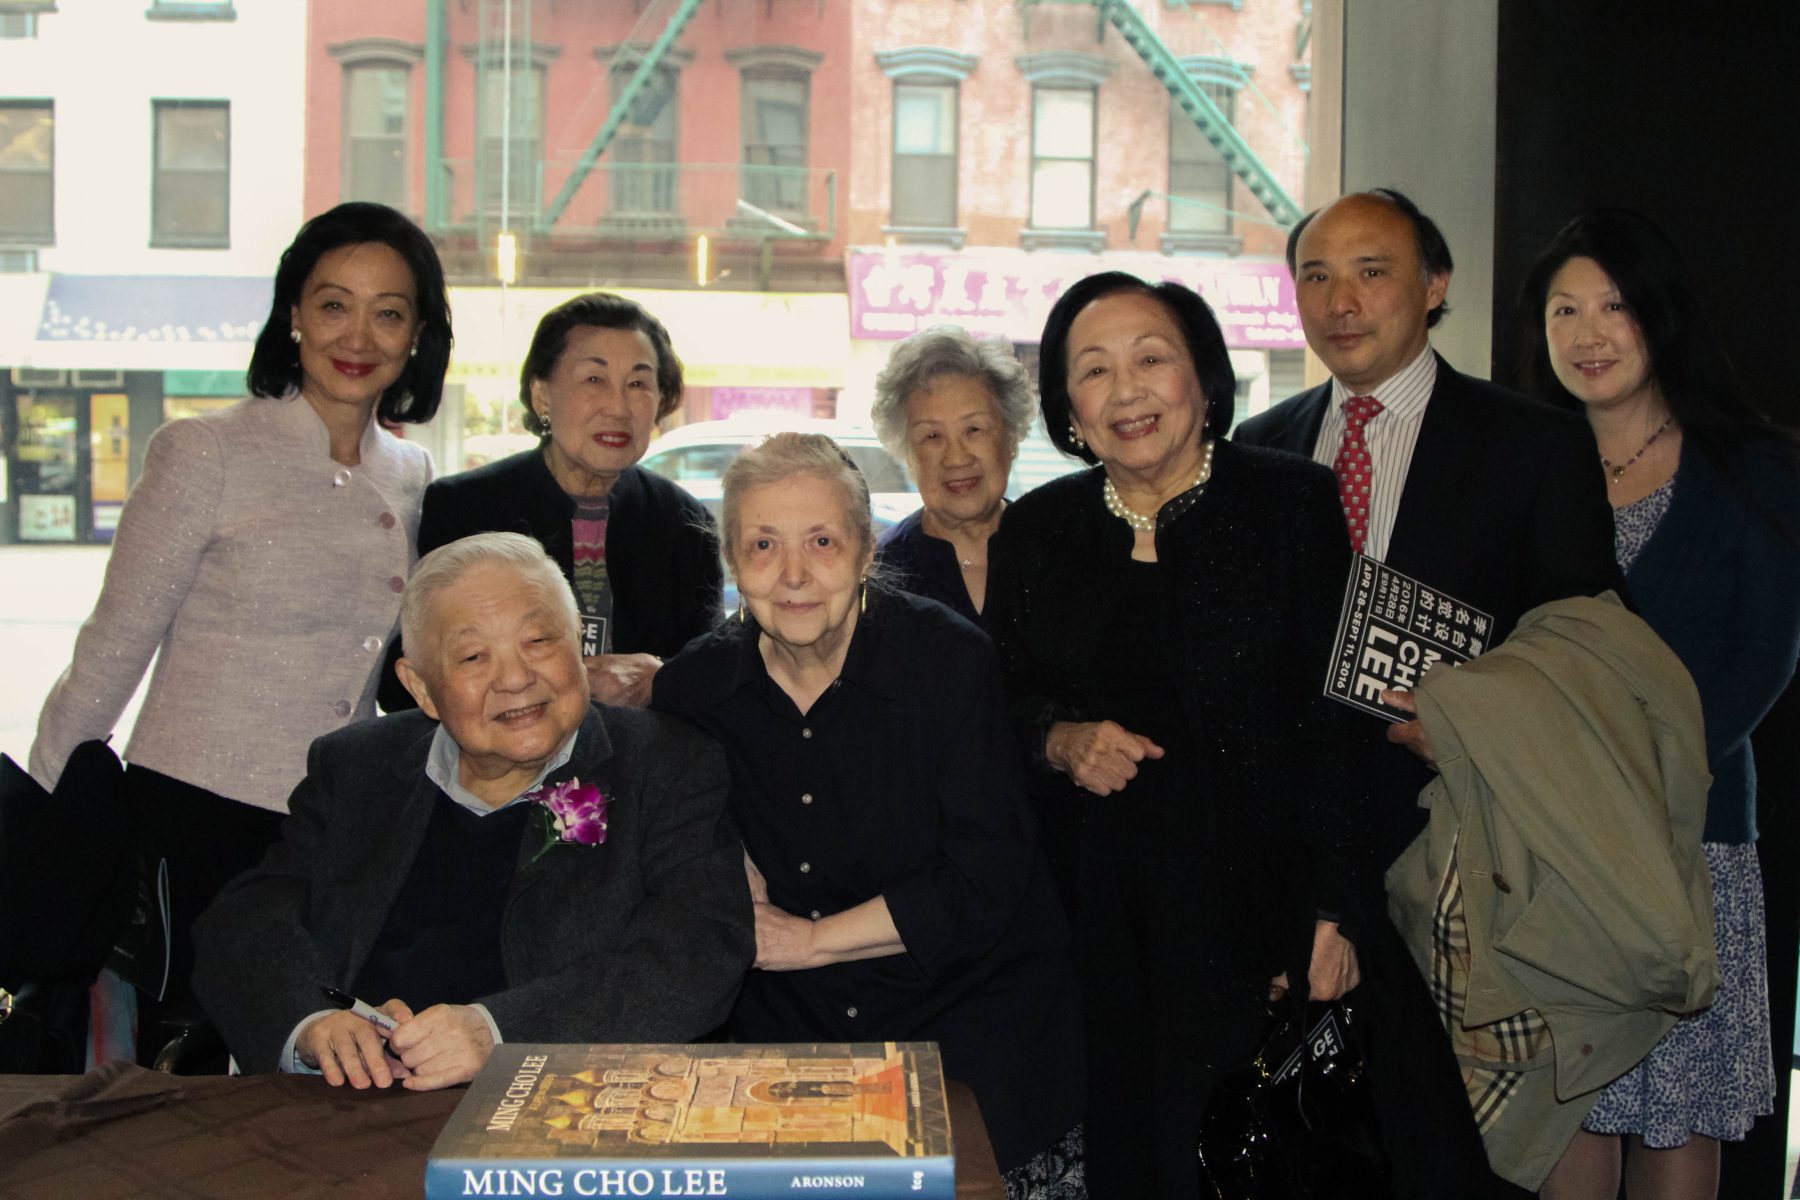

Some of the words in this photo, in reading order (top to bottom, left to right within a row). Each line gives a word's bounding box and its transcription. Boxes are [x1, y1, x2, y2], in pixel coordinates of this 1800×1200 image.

[1361, 563, 1373, 588] APR
[1385, 575, 1400, 620] 4月28日
[1397, 580, 1412, 624] 2016年
[1420, 588, 1487, 636] 李名觉的
[1336, 661, 1351, 689] 2016
[1354, 625, 1399, 705] LEE
[518, 1055, 548, 1074] LEE
[506, 1074, 537, 1098] CHO
[486, 1099, 525, 1131] MING
[462, 1169, 564, 1195] MING
[573, 1169, 654, 1196] CHO
[661, 1169, 727, 1196] LEE
[791, 1176, 865, 1188] ARONSON
